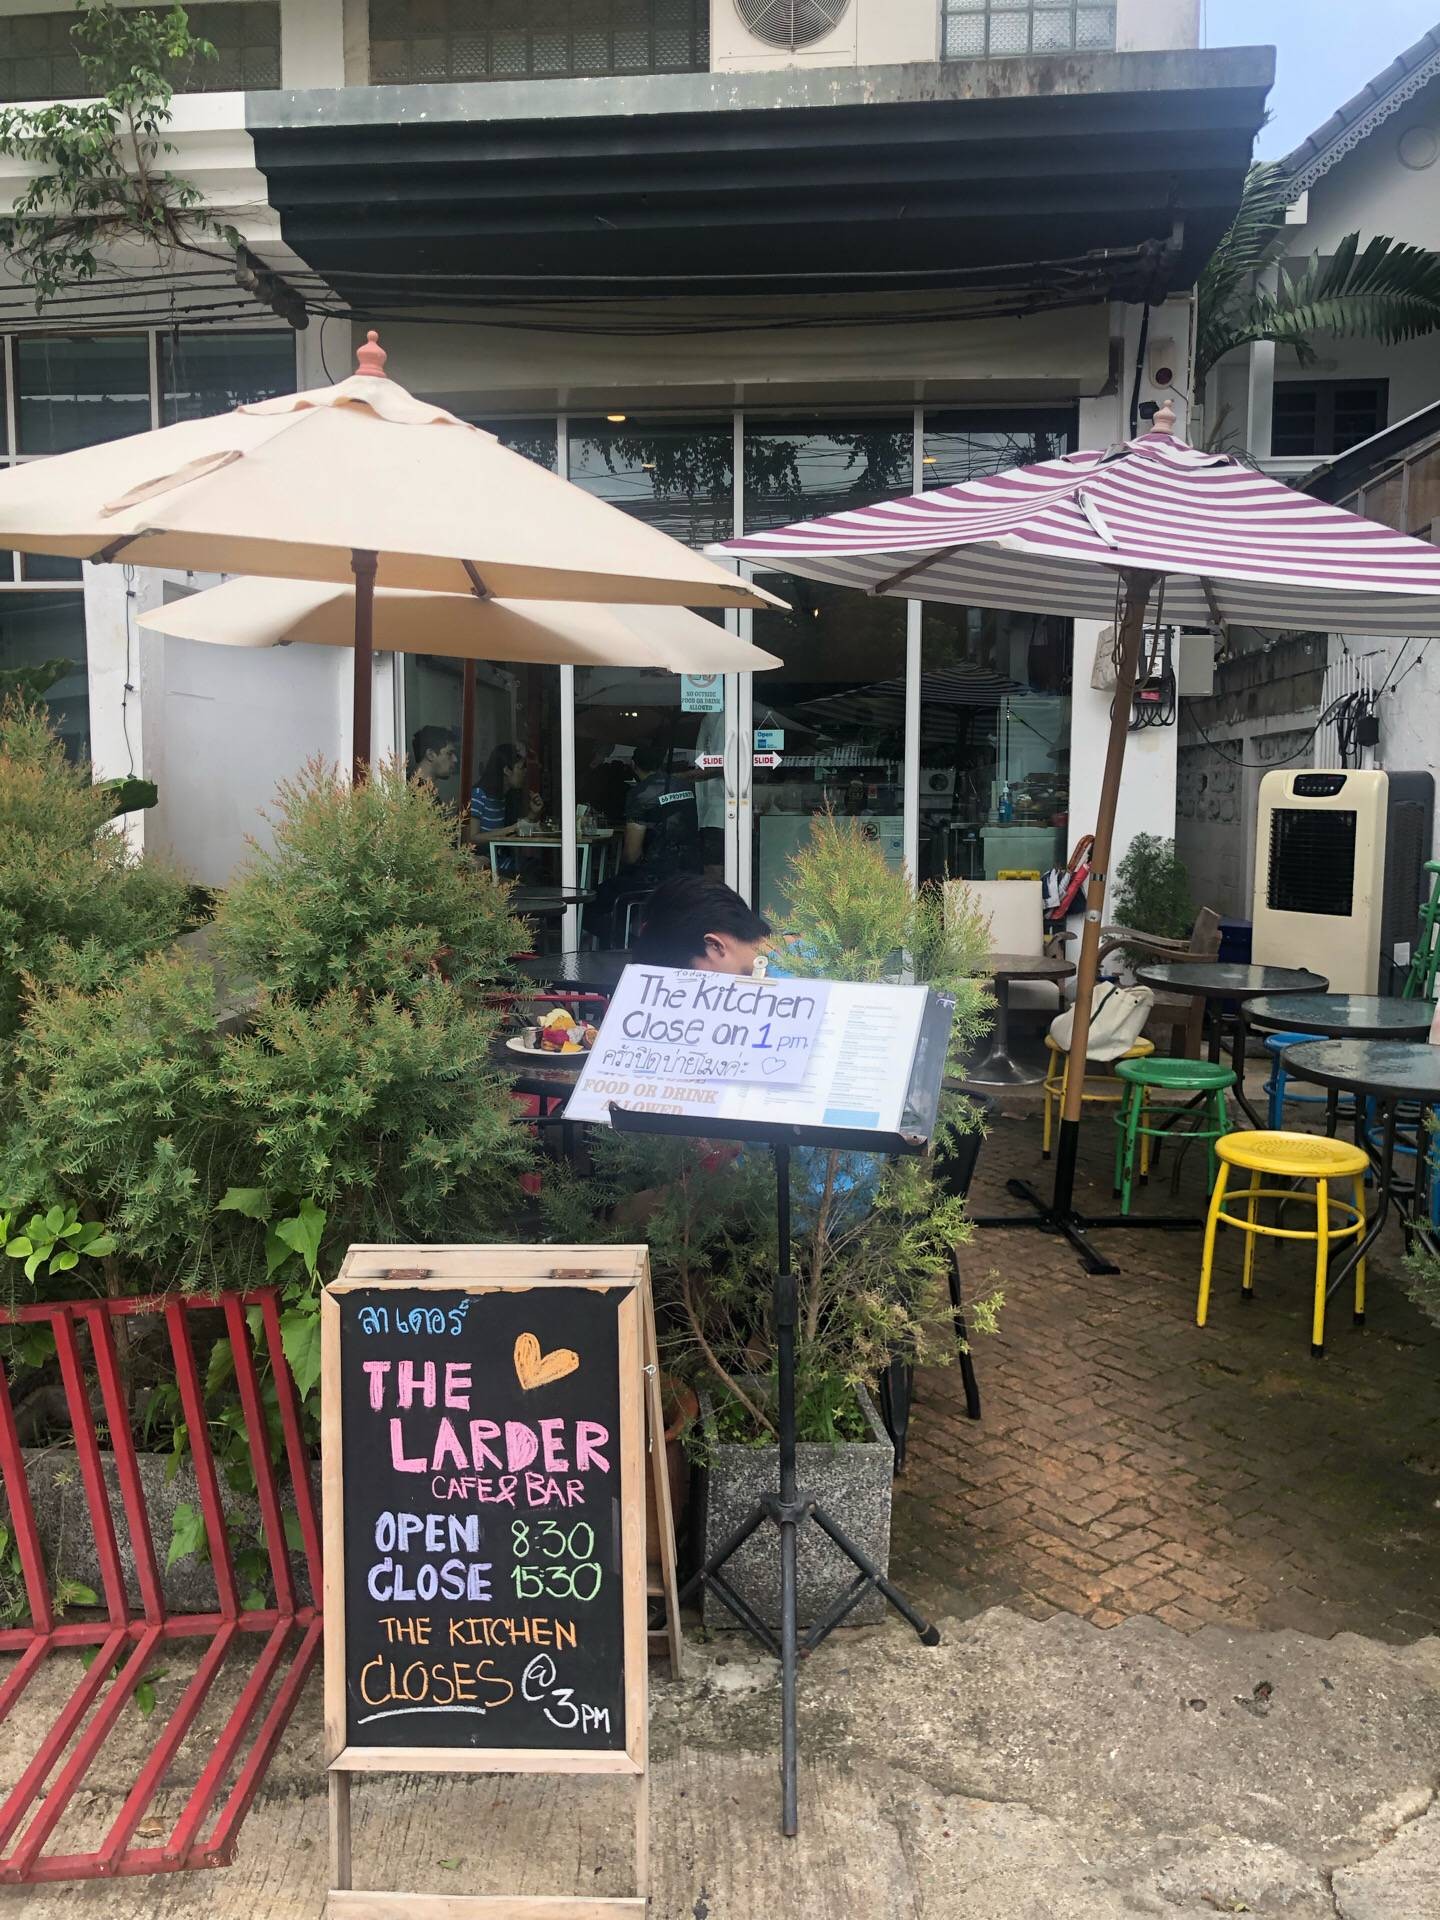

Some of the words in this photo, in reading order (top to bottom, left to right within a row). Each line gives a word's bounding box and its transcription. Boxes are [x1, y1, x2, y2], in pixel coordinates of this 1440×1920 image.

[702, 757, 722, 765] SLIDE
[640, 974, 687, 1009] The
[622, 1010, 705, 1045] Close
[711, 1023, 749, 1046] on
[751, 1022, 773, 1049] 1
[582, 1078, 629, 1095] FOOD
[633, 1083, 657, 1098] OR
[662, 1087, 719, 1105] DRINK
[600, 1100, 684, 1115] ALOWED
[363, 1360, 473, 1412] THE
[389, 1416, 611, 1474] LARDER
[374, 1511, 480, 1553] OPEN
[511, 1519, 595, 1560] 8:30
[367, 1556, 493, 1601] CLOSE
[510, 1562, 603, 1601] 15:30
[379, 1617, 433, 1645] THE
[449, 1616, 578, 1650] KITCHEN
[360, 1654, 514, 1707] CLOSES
[521, 1652, 557, 1702] @
